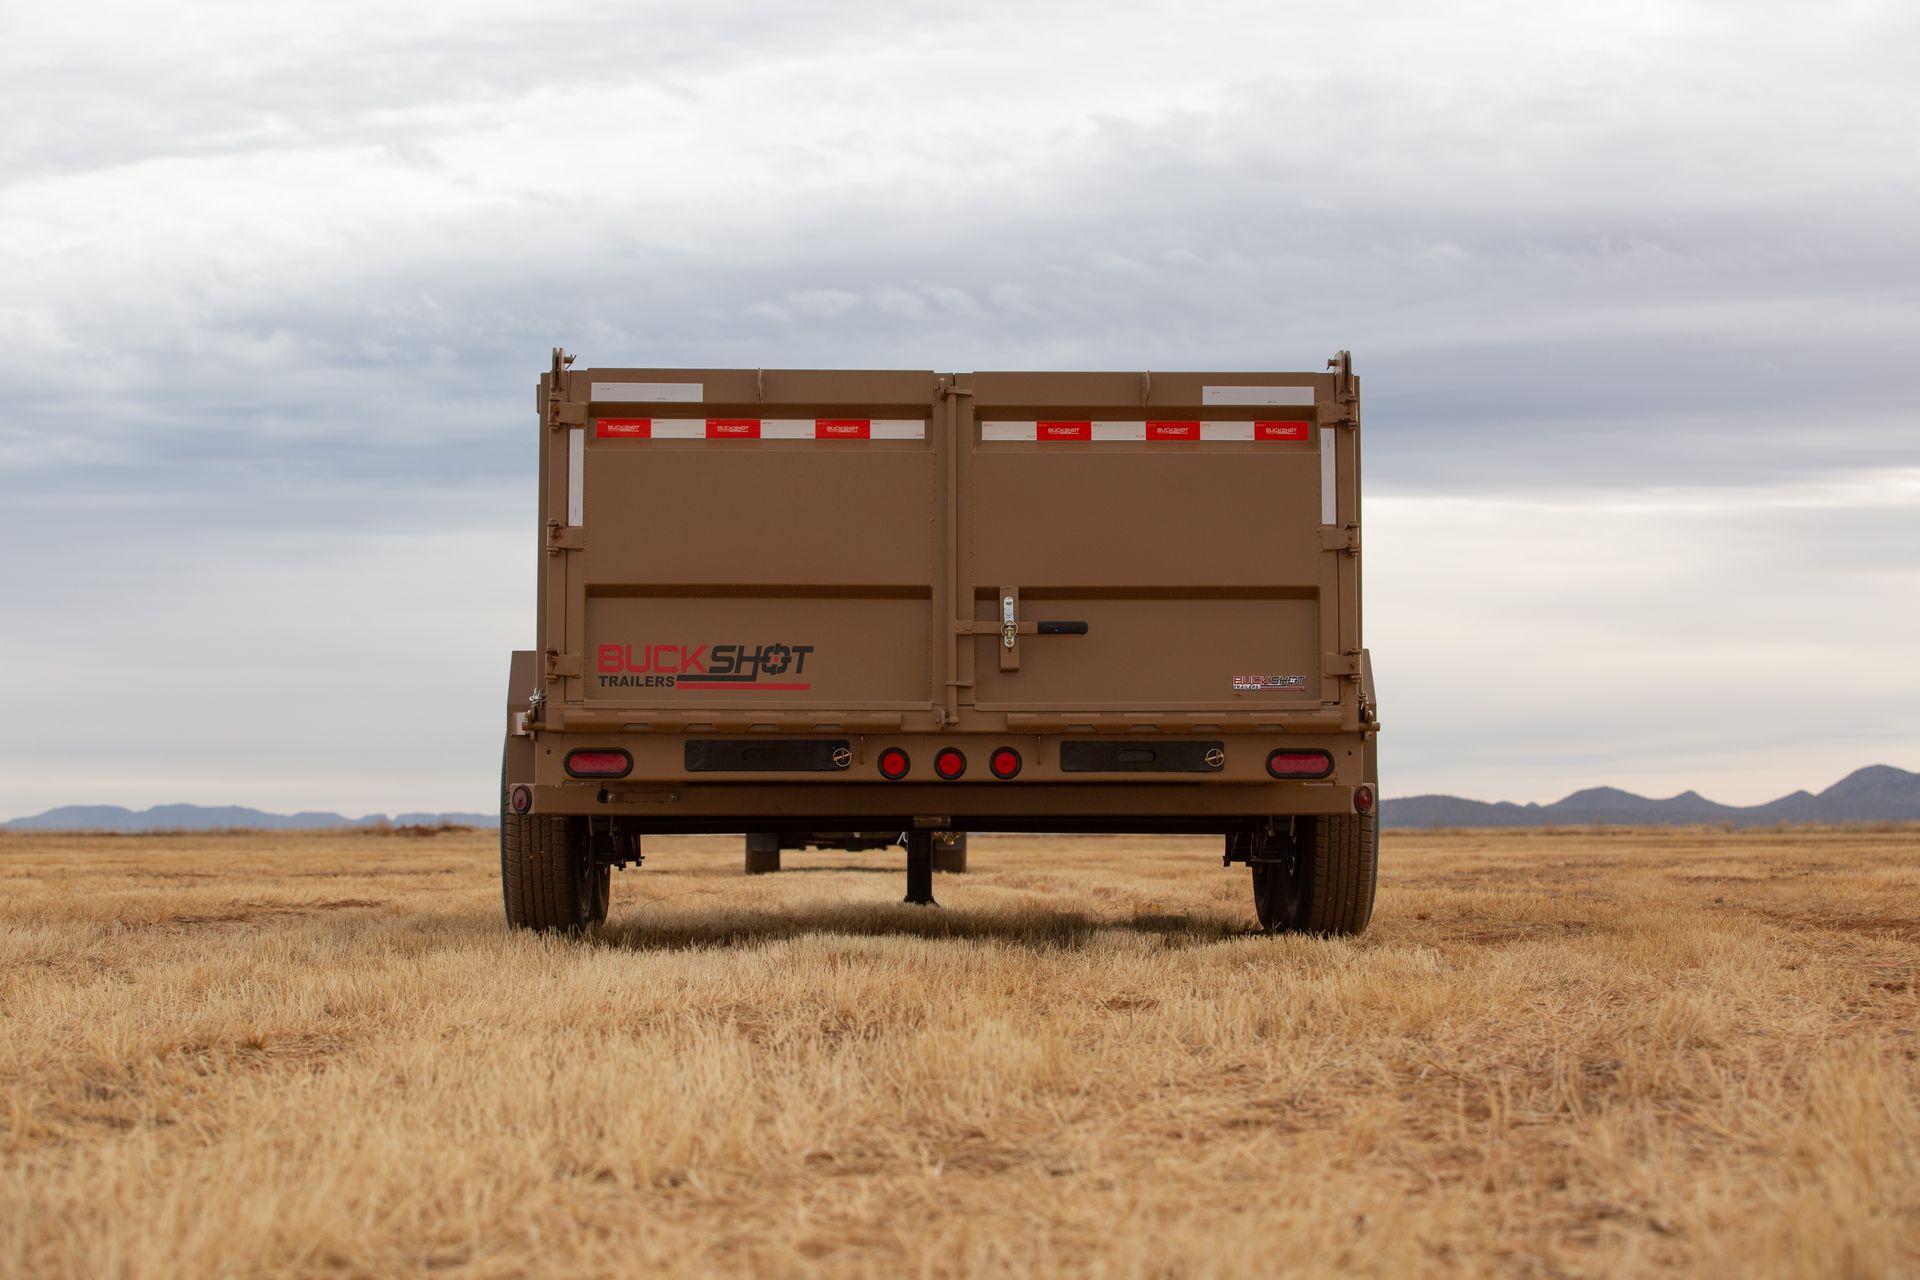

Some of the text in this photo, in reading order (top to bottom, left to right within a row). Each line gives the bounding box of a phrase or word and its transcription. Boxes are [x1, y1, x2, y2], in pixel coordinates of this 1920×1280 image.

[597, 643, 814, 676] BUCKSHOT
[599, 675, 675, 688] TRAILERS
[1233, 675, 1305, 685] BUCKSHOT
